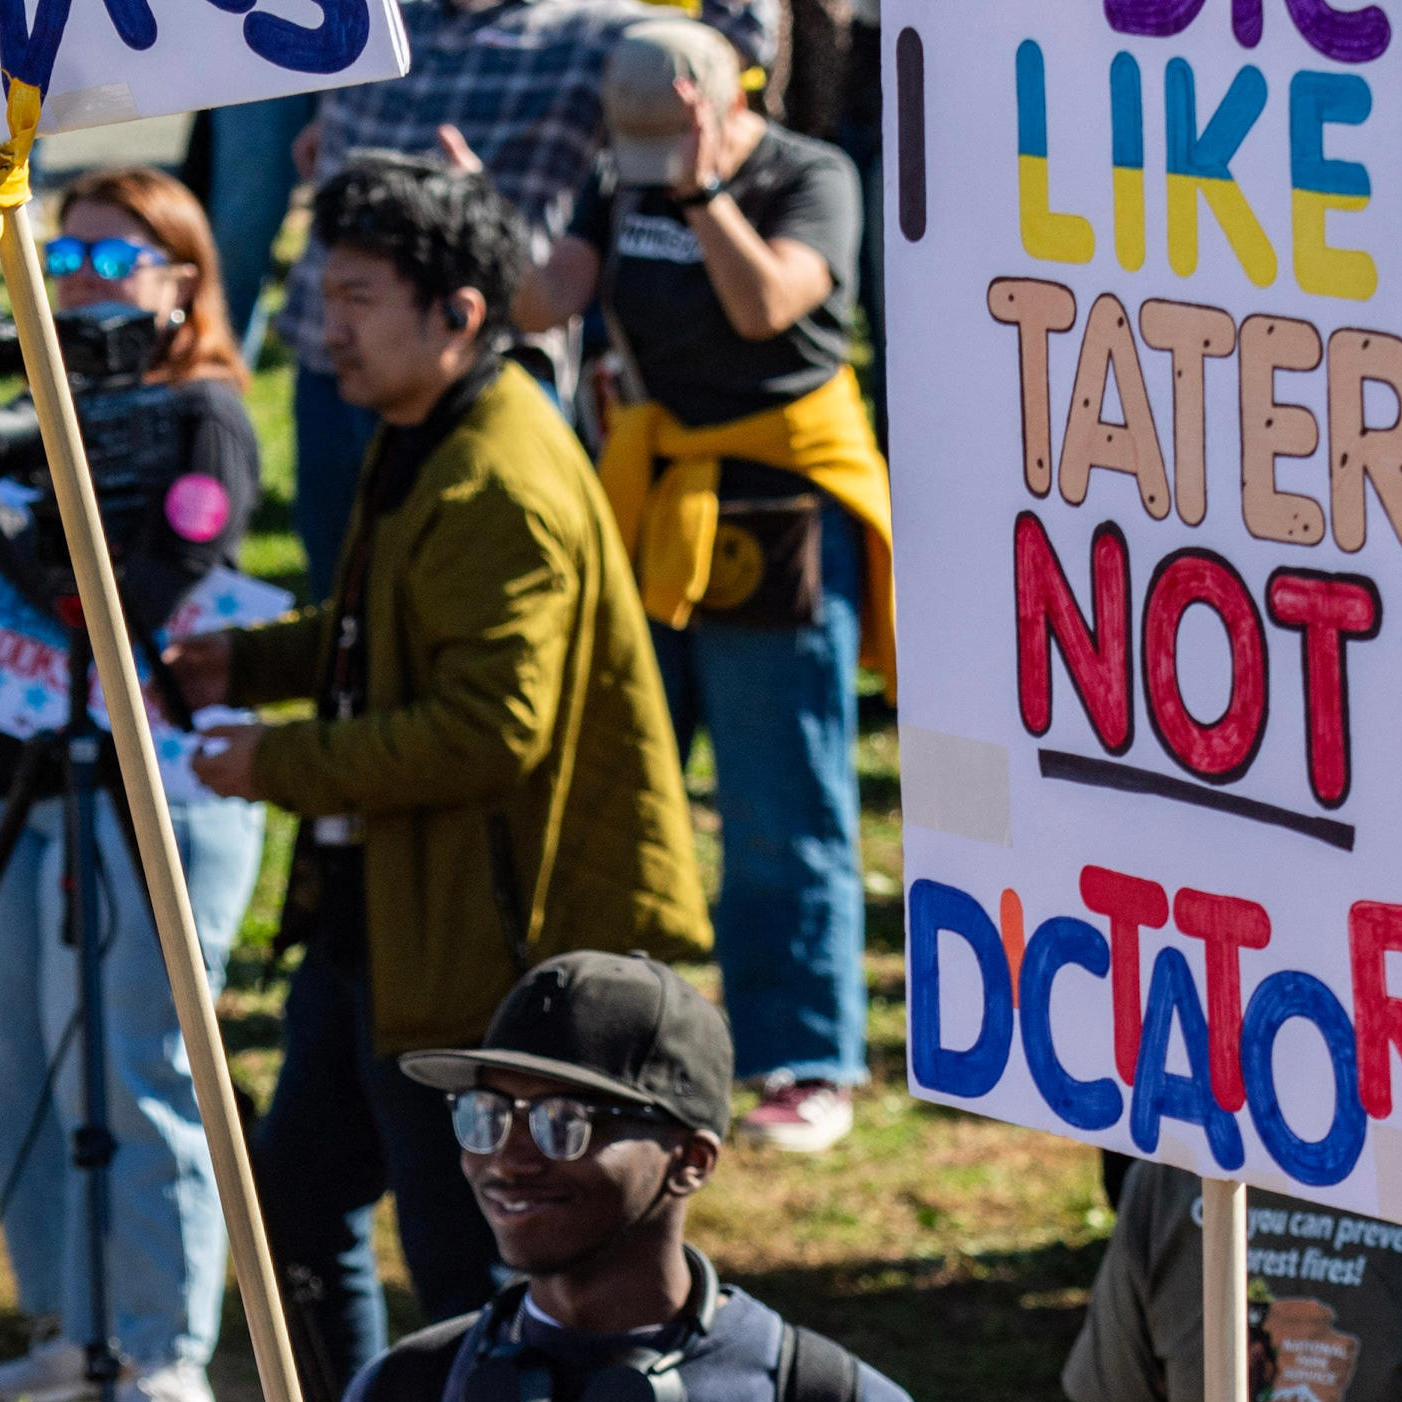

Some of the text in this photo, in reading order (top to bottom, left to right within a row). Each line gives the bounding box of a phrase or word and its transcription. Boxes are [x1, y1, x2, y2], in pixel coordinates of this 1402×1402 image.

[897, 26, 1378, 300] I LIKE
[1013, 509, 1383, 811] NOT
[1249, 1207, 1289, 1241] you
[1288, 1210, 1335, 1240] can
[1300, 1246, 1367, 1287] fires!
[1282, 1339, 1348, 1359] NATIONAL
